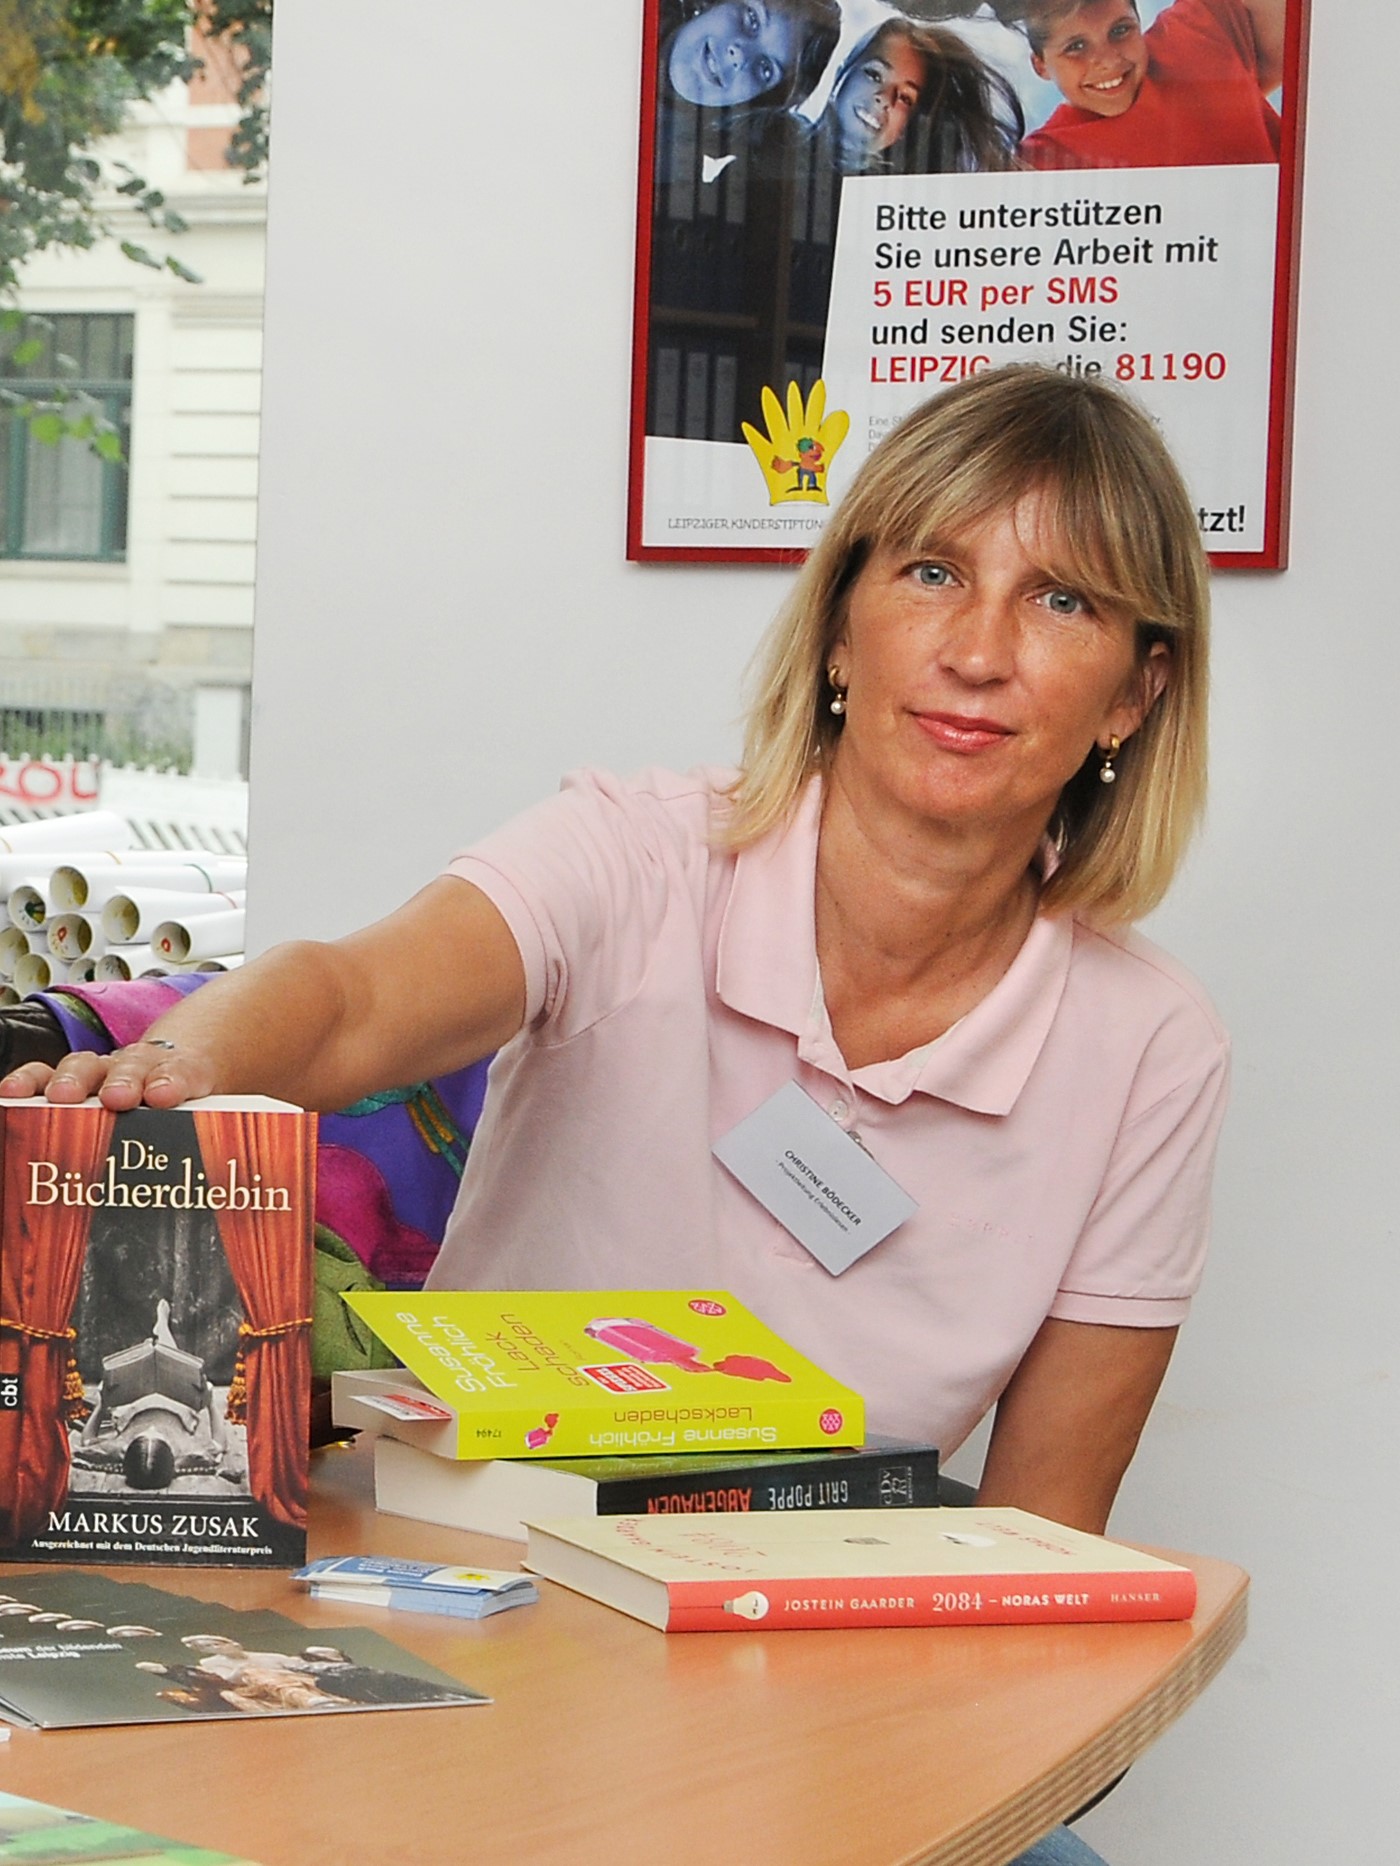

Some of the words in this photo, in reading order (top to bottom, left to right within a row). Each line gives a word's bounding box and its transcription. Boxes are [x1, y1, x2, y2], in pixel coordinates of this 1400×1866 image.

[875, 204, 947, 231] Bitte
[958, 199, 1163, 229] unterstützen
[874, 242, 922, 269] Sie
[934, 244, 1041, 268] unsere
[1053, 237, 1154, 267] Arbeit
[1165, 236, 1219, 264] mit
[873, 281, 892, 307] 5
[905, 279, 968, 307] EUR
[981, 283, 1034, 312] per
[1046, 276, 1119, 304] SMS
[871, 318, 928, 345] und
[940, 317, 1055, 344] senden
[1067, 315, 1128, 343] Sie:
[1115, 352, 1227, 381] 81190
[668, 518, 729, 530] LEIPZIGER
[731, 518, 824, 531] KINDERSTIFTUN
[120, 1139, 169, 1171] Die
[26, 1155, 292, 1212] Bücherdiebin
[784, 1149, 824, 1188] CHRISTINE
[821, 1185, 862, 1226] BÖDECKER
[395, 1311, 486, 1393] Susanne
[432, 1314, 517, 1389] Fröhlich
[485, 1331, 540, 1373] Lack
[500, 1313, 590, 1387] schaden
[0, 1377, 18, 1407] cbt
[614, 1407, 753, 1424] Lackschaden
[589, 1430, 675, 1449] Fröhlich
[683, 1426, 777, 1443] Susanne
[768, 1484, 812, 1510] POPPE
[818, 1480, 849, 1505] GRIT
[48, 1511, 163, 1535] MARKUS
[171, 1515, 259, 1538] ZUSAK
[134, 1541, 181, 1553] Deutschen
[783, 1598, 844, 1611] JOSTEIN
[850, 1596, 915, 1610] GAARDER
[932, 1592, 983, 1613] 2084
[1001, 1593, 1049, 1607] NORAS
[1054, 1592, 1089, 1606] WELT
[1110, 1592, 1161, 1603] HANSER
